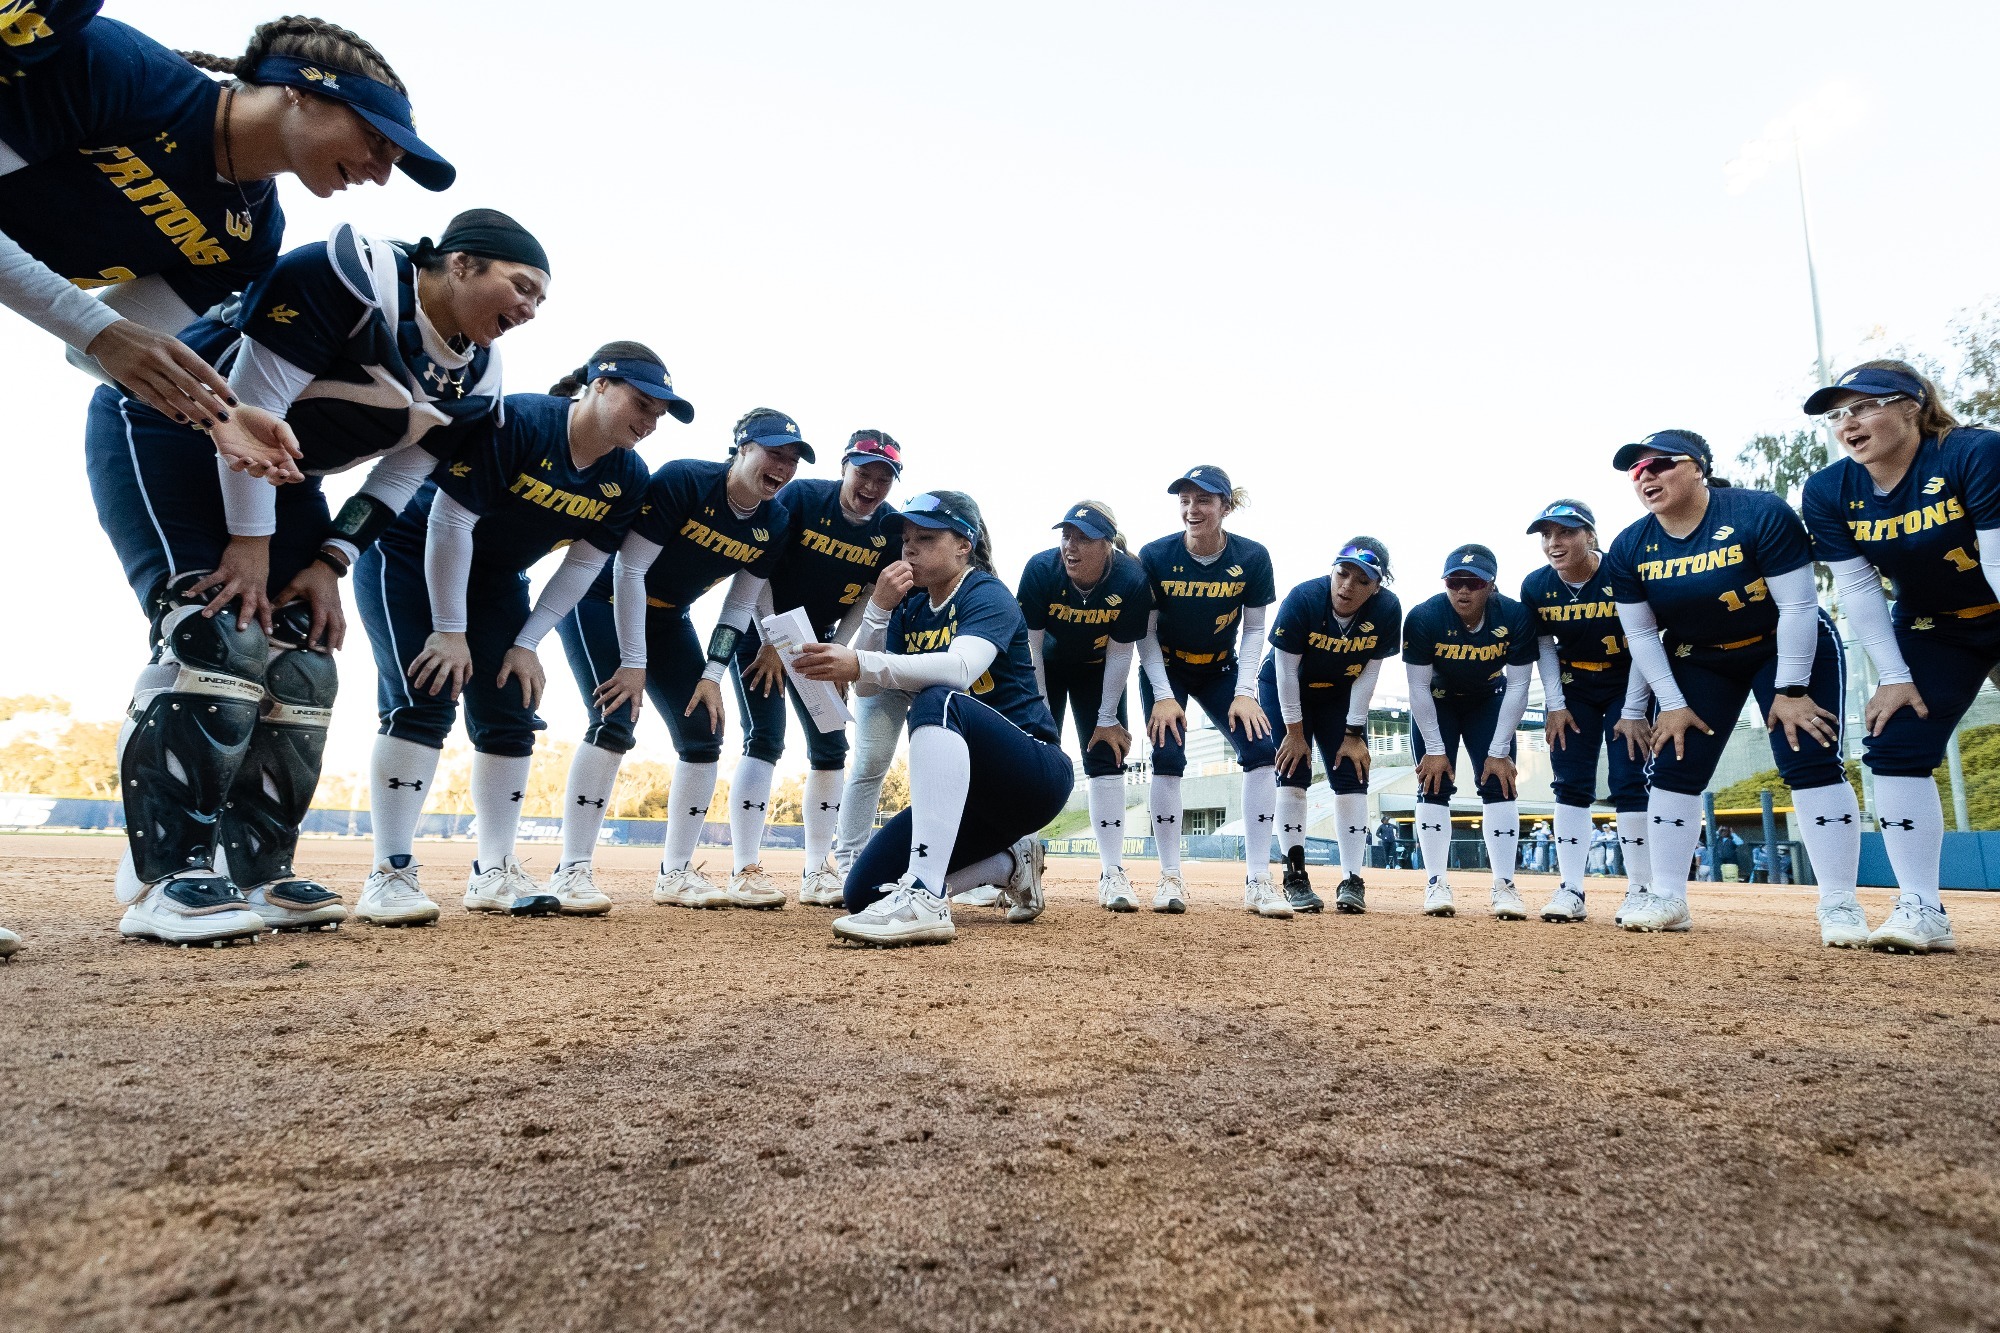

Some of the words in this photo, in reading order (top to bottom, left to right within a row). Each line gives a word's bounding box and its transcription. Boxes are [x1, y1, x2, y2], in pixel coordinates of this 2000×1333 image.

[1847, 496, 1965, 541] RITONS
[1637, 544, 1744, 581] TRITONS
[1160, 580, 1246, 598] TRITONS
[1048, 603, 1121, 624] TRTONS
[1538, 601, 1619, 621] TRITON
[1434, 642, 1510, 661] TRITON
[198, 676, 237, 687] UNDER
[1047, 839, 1069, 853] TRITON
[1071, 839, 1100, 853] SOFTBA
[1122, 839, 1145, 854] DIUM
